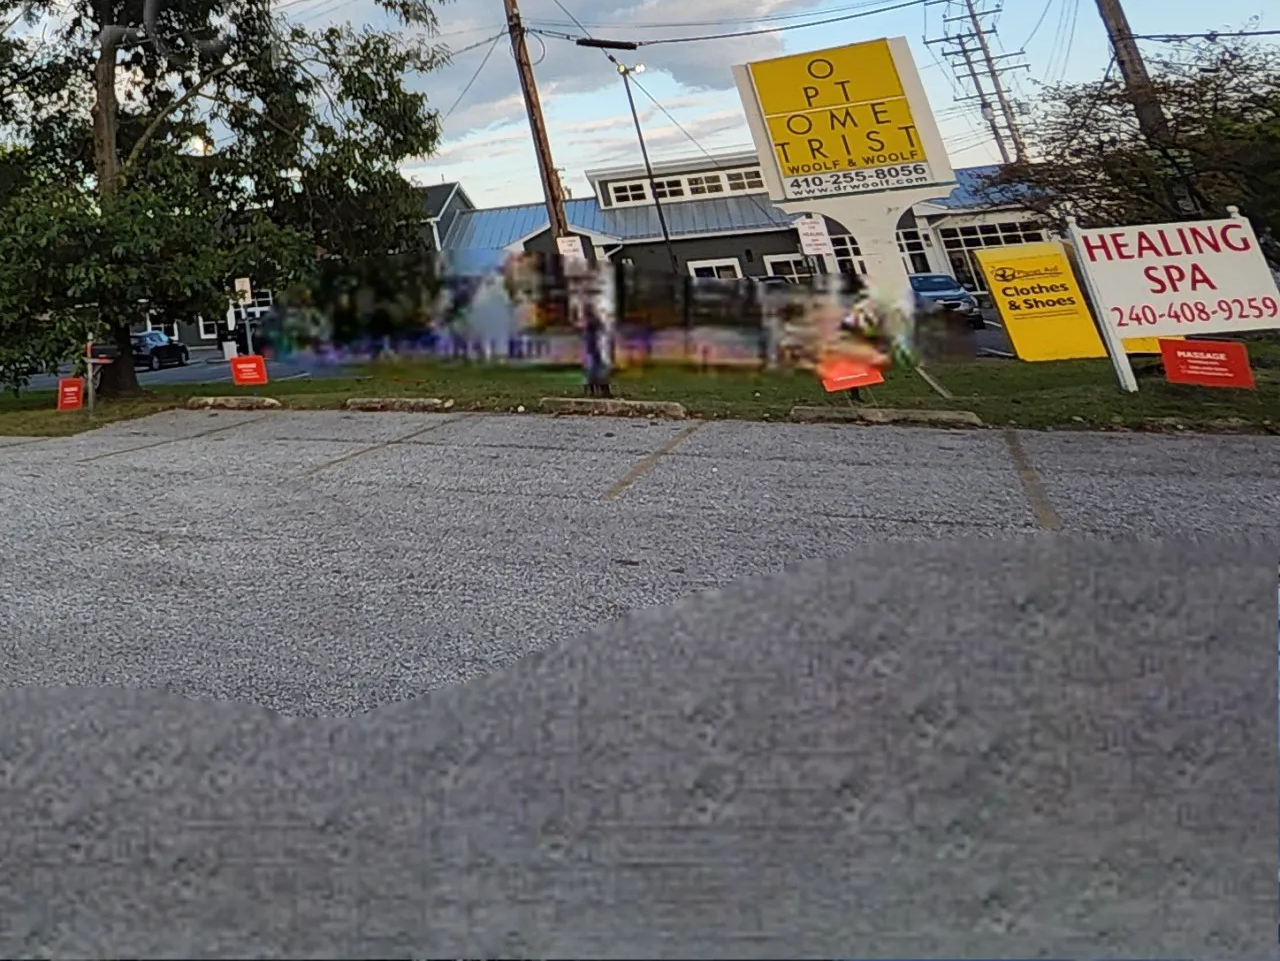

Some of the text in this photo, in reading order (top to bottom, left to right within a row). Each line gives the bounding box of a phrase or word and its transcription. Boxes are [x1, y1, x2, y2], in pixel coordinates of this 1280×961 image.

[788, 150, 919, 175] WOOLF & WOOLF
[790, 164, 927, 189] 410-255-8056
[792, 176, 928, 197] www.drwoolf.com
[1081, 223, 1252, 263] HEALING
[1001, 282, 1070, 298] Clothes
[1143, 262, 1218, 294] SPA
[1007, 295, 1076, 311] & Shoes
[1111, 296, 1279, 328] 240-408-9259
[1176, 350, 1228, 361] MASSAGE
